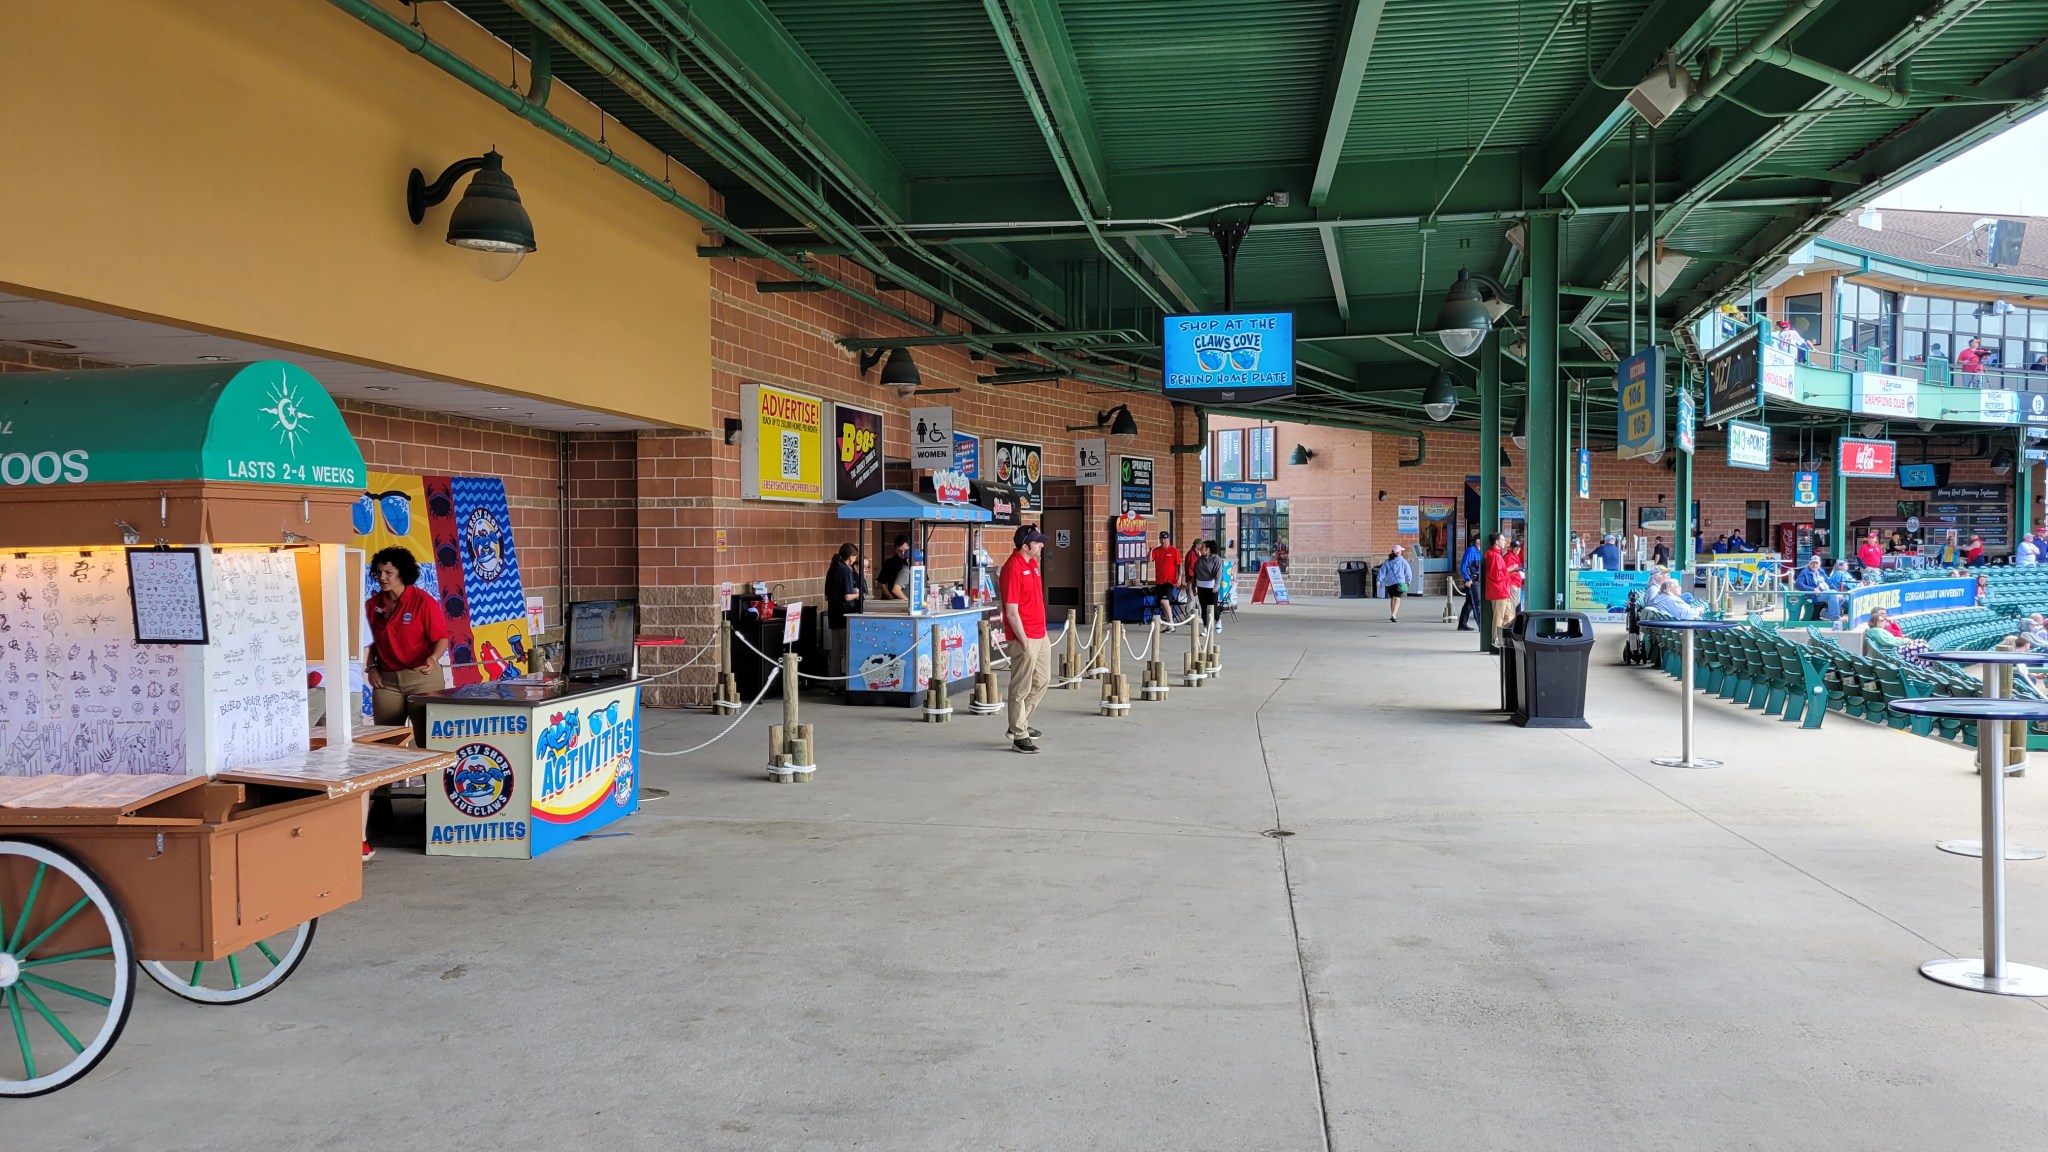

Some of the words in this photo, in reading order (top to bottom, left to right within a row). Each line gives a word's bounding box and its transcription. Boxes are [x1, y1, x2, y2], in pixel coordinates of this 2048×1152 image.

[1180, 320, 1219, 332] SHOP
[1225, 319, 1244, 331] AT
[1249, 317, 1276, 329] THE
[1194, 334, 1231, 349] CLAWS
[1233, 333, 1261, 347] COVE
[1170, 374, 1213, 385] BEHIND
[1217, 373, 1248, 384] HOME
[1252, 372, 1287, 383] PLATE
[1629, 385, 1641, 406] 106
[1864, 394, 1893, 407] CHAMPIONS
[1893, 397, 1905, 409] CLUB
[762, 393, 819, 426] ADVERTISE!
[1632, 414, 1646, 435] 105
[917, 450, 947, 459] WOMEN
[1012, 446, 1027, 467] RAM
[0, 449, 89, 485] OOS
[228, 459, 275, 479] LASTS
[282, 463, 306, 481] 2-4
[312, 465, 355, 484] WEEKS
[467, 509, 483, 542] JERSEY
[484, 510, 502, 539] SHORE
[1614, 572, 1635, 581] Menu
[1904, 592, 1925, 602] GEORGIAN
[1924, 590, 1938, 600] COURT
[1938, 588, 1964, 599] UNIVERSITY
[575, 656, 593, 668] FREE
[594, 654, 606, 666] TO
[220, 700, 241, 715] BUILD
[243, 695, 261, 711] YOUR
[431, 715, 528, 738] ACTIVITIES
[483, 744, 512, 778] SHORE
[541, 718, 634, 803] ACTIVITIES
[449, 789, 508, 817] BLUECLAWS
[431, 821, 527, 843] ACTIVITIES
